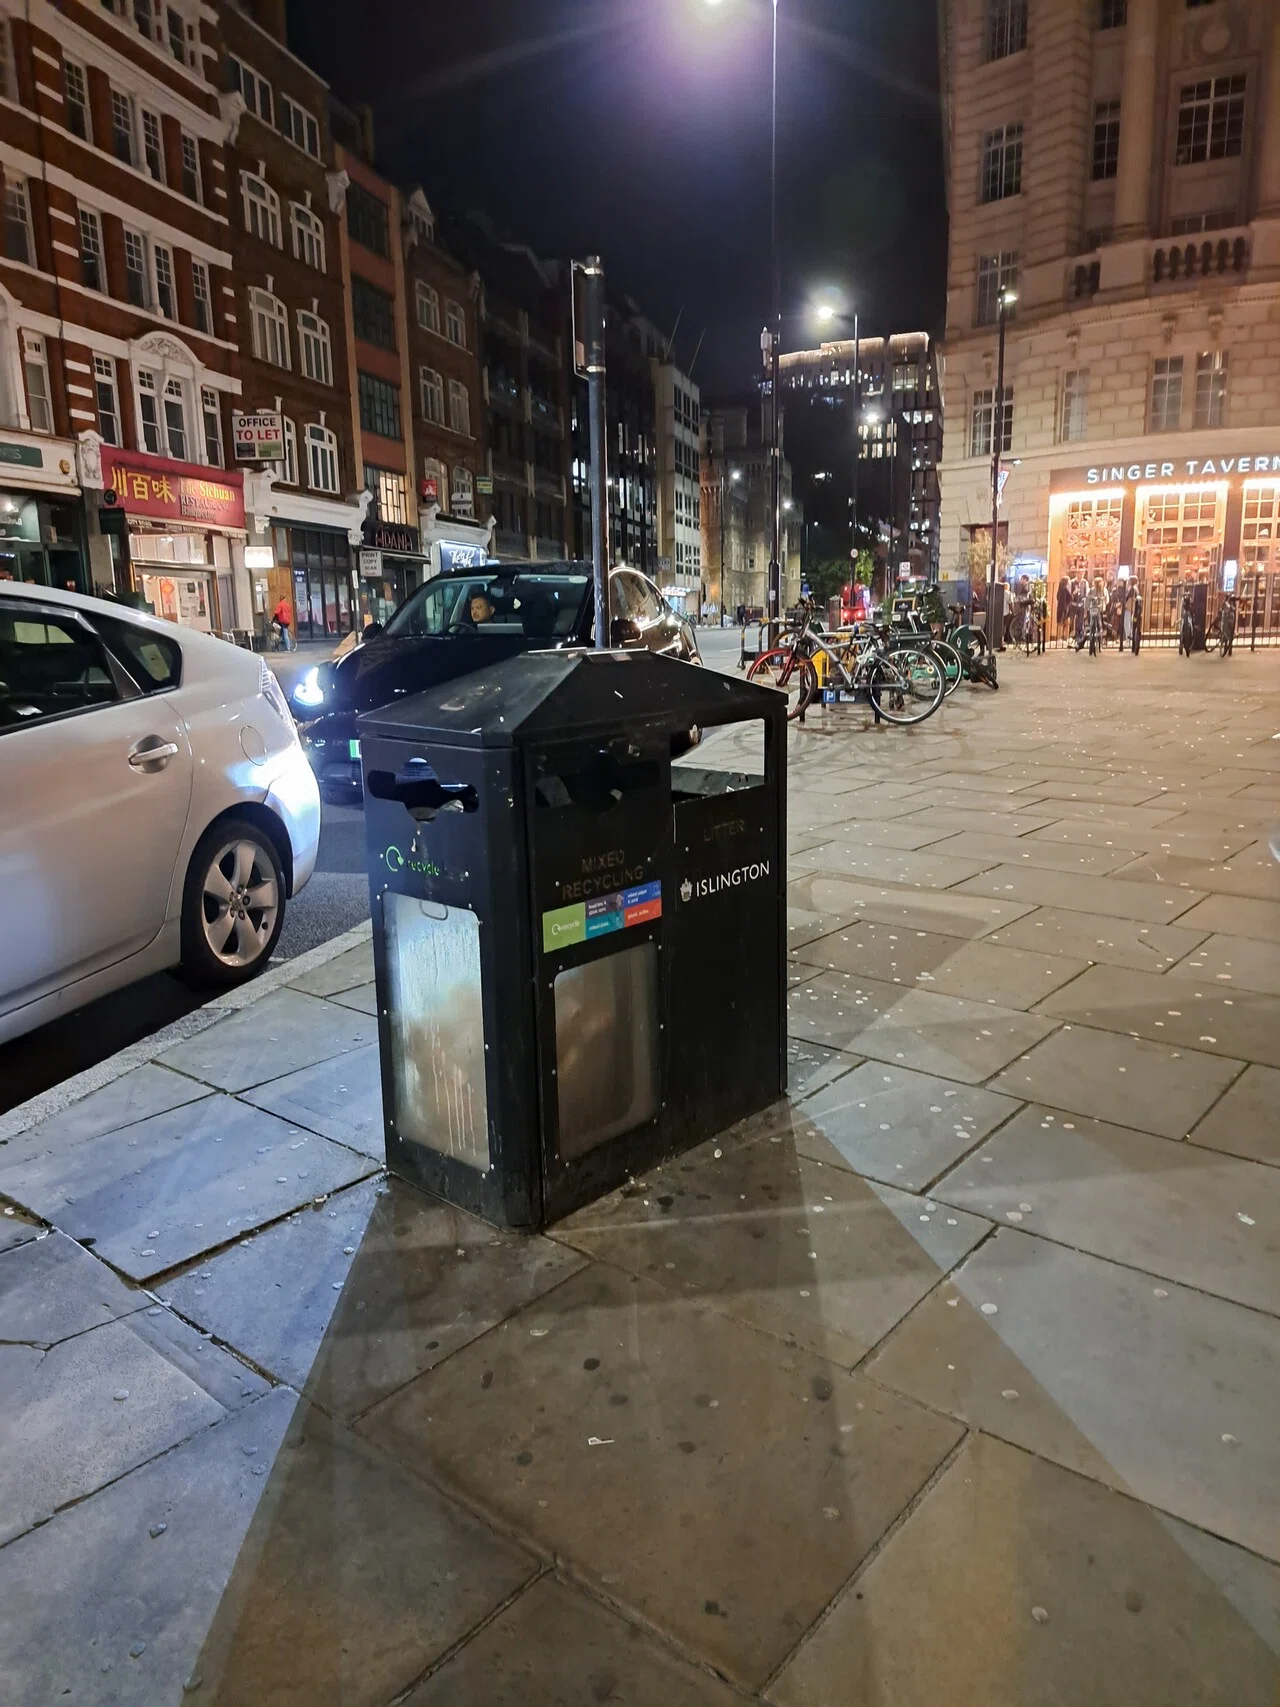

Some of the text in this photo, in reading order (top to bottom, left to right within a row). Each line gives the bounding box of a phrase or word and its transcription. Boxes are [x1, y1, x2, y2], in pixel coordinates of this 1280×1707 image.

[239, 417, 276, 427] OFFICE
[236, 429, 280, 441] TO LET
[1087, 463, 1174, 483] SINGER
[111, 466, 177, 504] 川百味
[199, 481, 235, 502] Sichuan
[703, 819, 745, 843] LITTER
[581, 850, 625, 873] MIXED
[562, 864, 644, 900] RECYCLING
[696, 859, 770, 897] ISLINGTON
